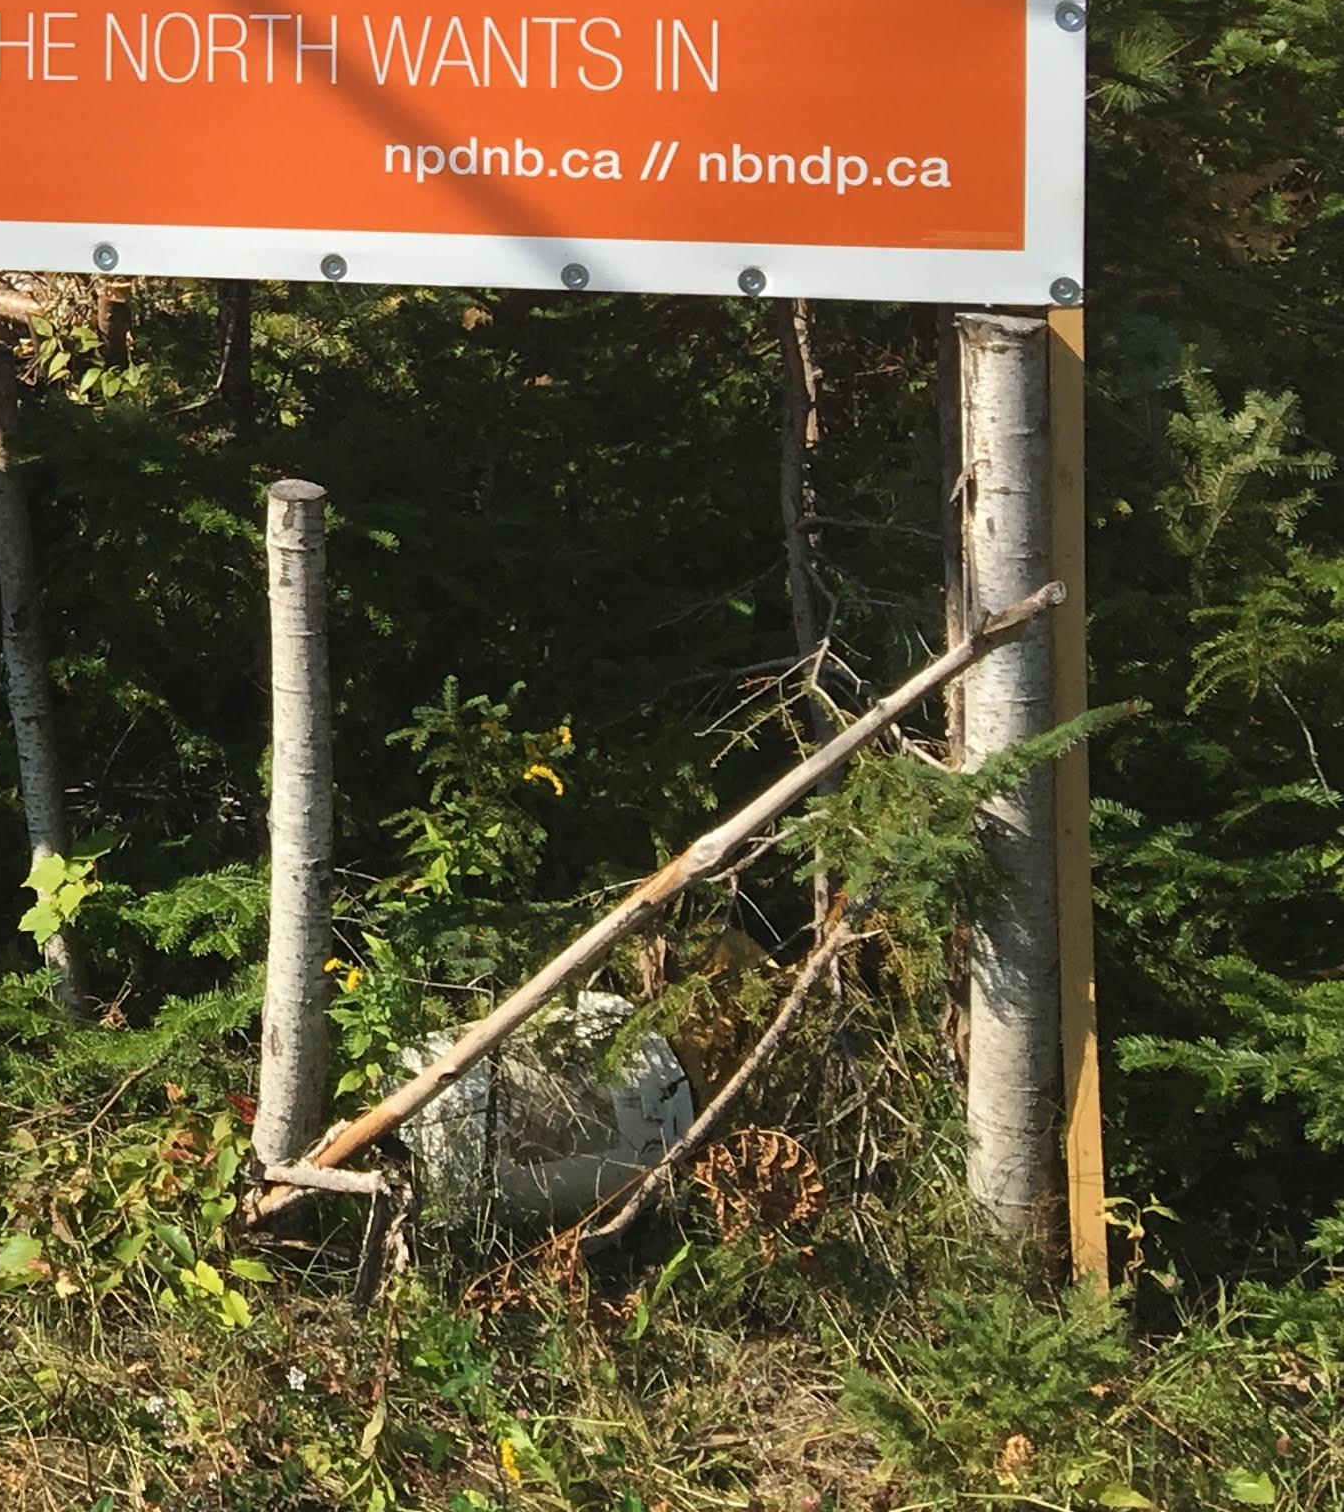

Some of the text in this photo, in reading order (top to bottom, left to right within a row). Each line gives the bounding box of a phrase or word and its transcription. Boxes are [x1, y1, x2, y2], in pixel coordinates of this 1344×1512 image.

[105, 12, 337, 85] NORTH
[363, 16, 623, 92] WANTS
[655, 19, 720, 93] IN
[383, 134, 621, 184] npdnb.ca
[698, 140, 952, 196] nbndp.ca
